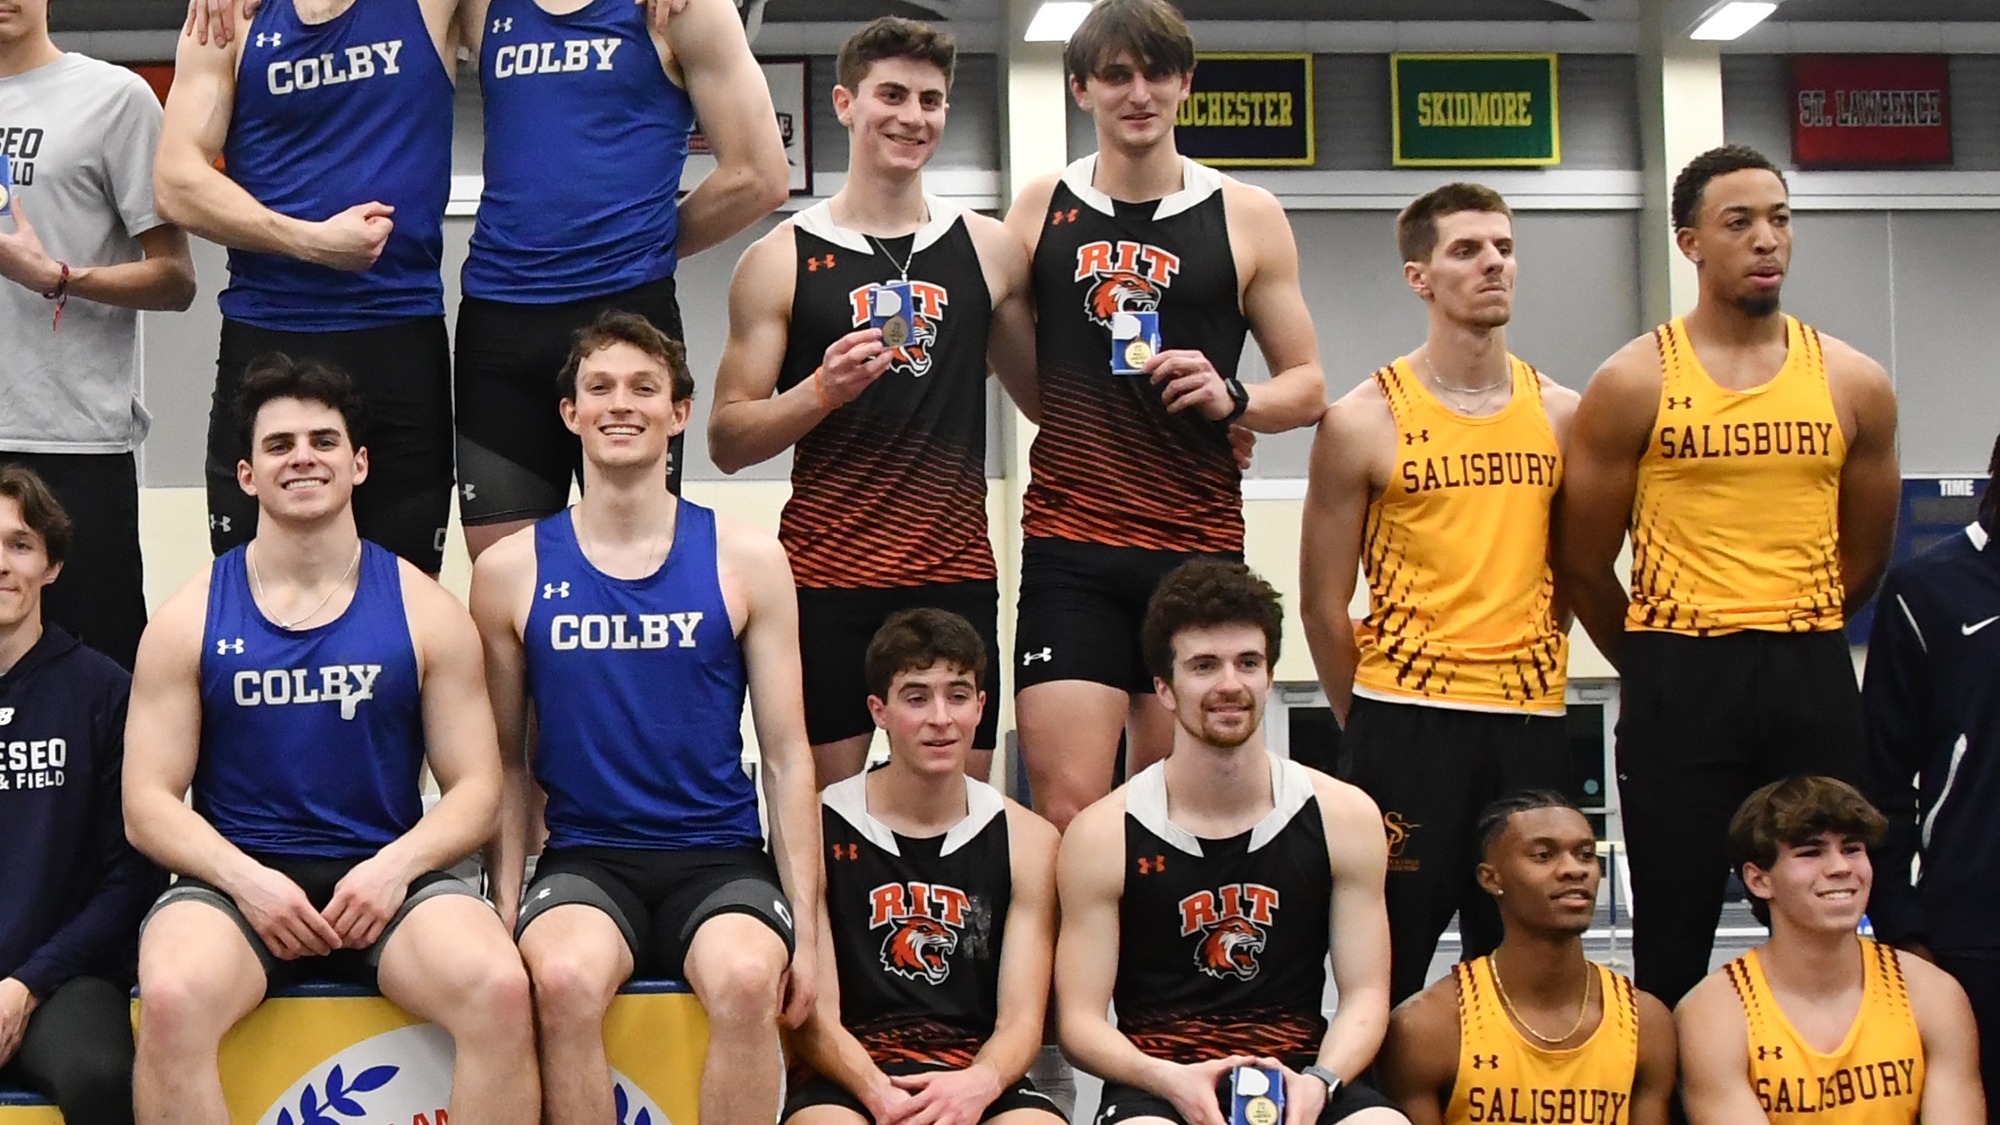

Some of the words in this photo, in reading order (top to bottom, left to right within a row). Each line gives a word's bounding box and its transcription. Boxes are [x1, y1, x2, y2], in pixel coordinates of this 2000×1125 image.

[267, 39, 403, 95] COLBY
[495, 38, 622, 79] COLBY
[1174, 91, 1294, 127] OCHESTER
[1417, 91, 1533, 127] SKIDMORE
[1799, 90, 1833, 127] ST.
[1835, 89, 1941, 127] LAWRENCE
[1074, 240, 1181, 289] RIT
[1659, 421, 1833, 459] SALISBURY
[1402, 452, 1557, 494] SALISBURY
[1939, 479, 1975, 497] TIME
[551, 611, 704, 651] COLBY
[233, 664, 382, 707] COLBY
[16, 770, 65, 789] FIELD
[869, 881, 972, 931] RIT
[1178, 883, 1280, 938] RIT
[1756, 1058, 1914, 1113] SALISBURY
[1469, 1087, 1627, 1125] SALISBURY
